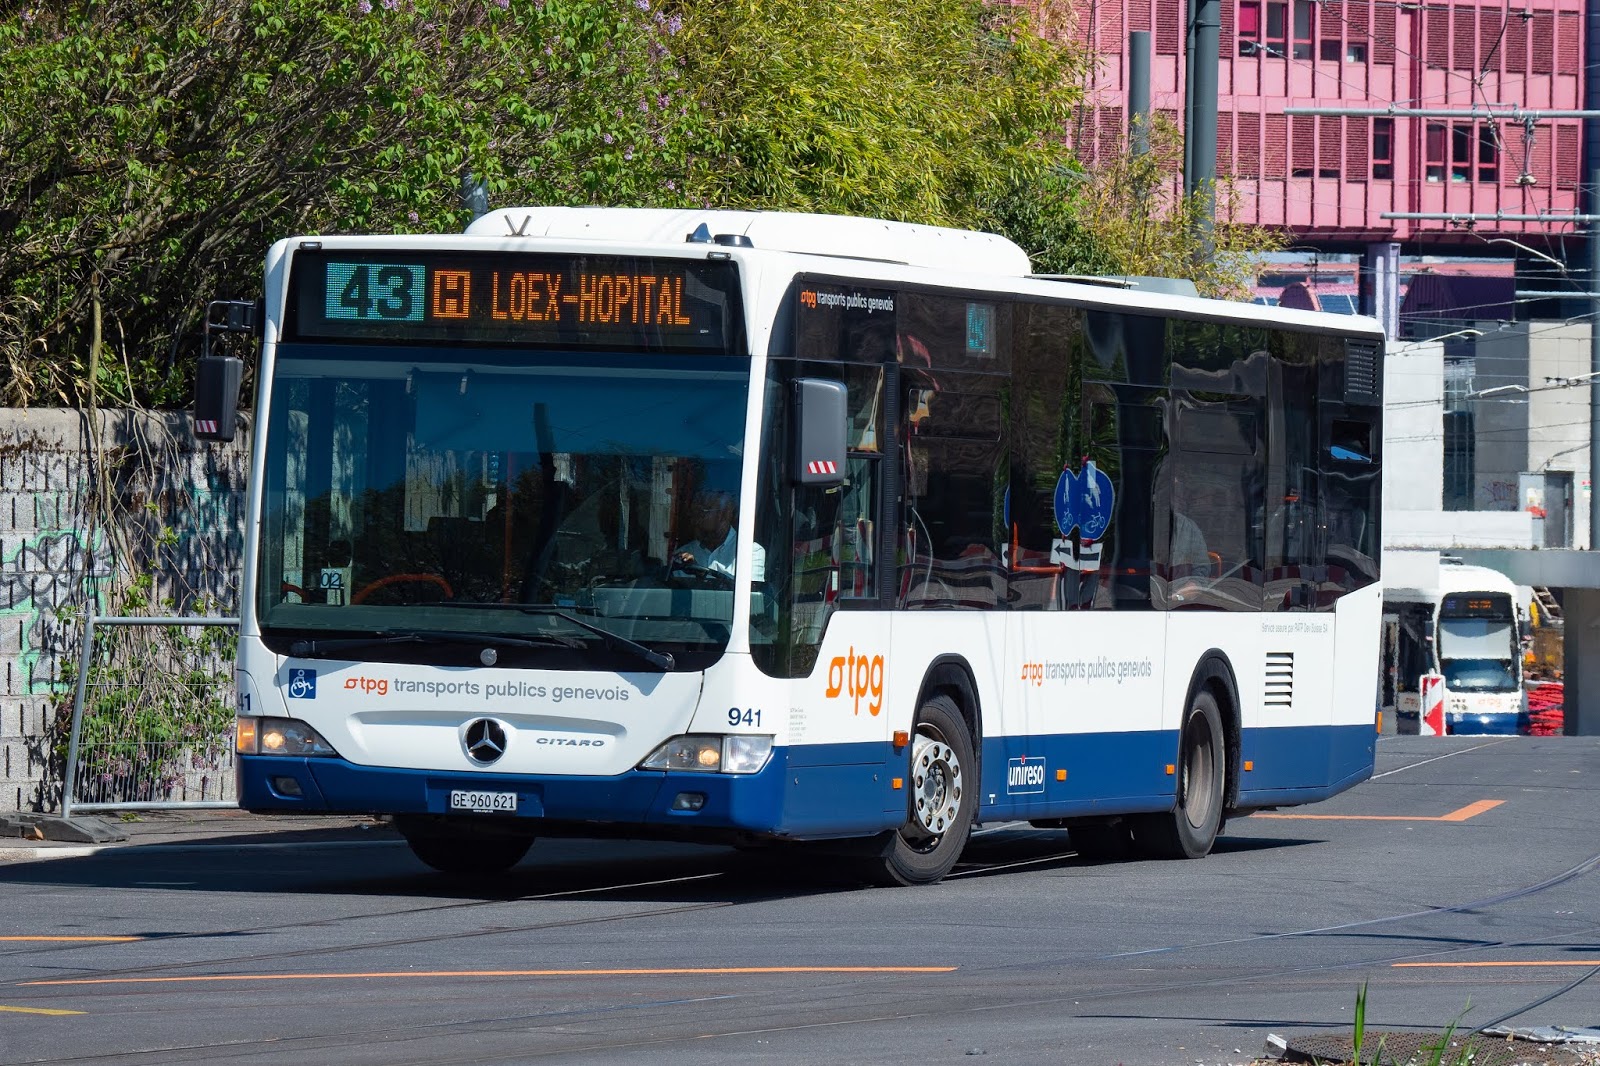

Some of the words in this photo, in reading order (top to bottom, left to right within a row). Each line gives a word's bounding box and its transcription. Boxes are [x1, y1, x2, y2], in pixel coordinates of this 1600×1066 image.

[340, 265, 414, 318] 43
[436, 273, 467, 315] H
[492, 272, 690, 324] LOEX-HOPITAL
[817, 291, 846, 309] transports
[847, 293, 867, 310] publics
[868, 296, 894, 314] genevois
[321, 572, 340, 587] 02
[1045, 659, 1086, 686] transports
[1087, 656, 1116, 685] publics
[1117, 656, 1152, 684] genevois
[236, 692, 251, 711] 41
[394, 678, 480, 697] transports
[485, 681, 547, 700] publics
[552, 686, 629, 703] genevois
[728, 707, 761, 728] 941
[536, 737, 605, 747] CITARO
[1009, 755, 1044, 786] unireso
